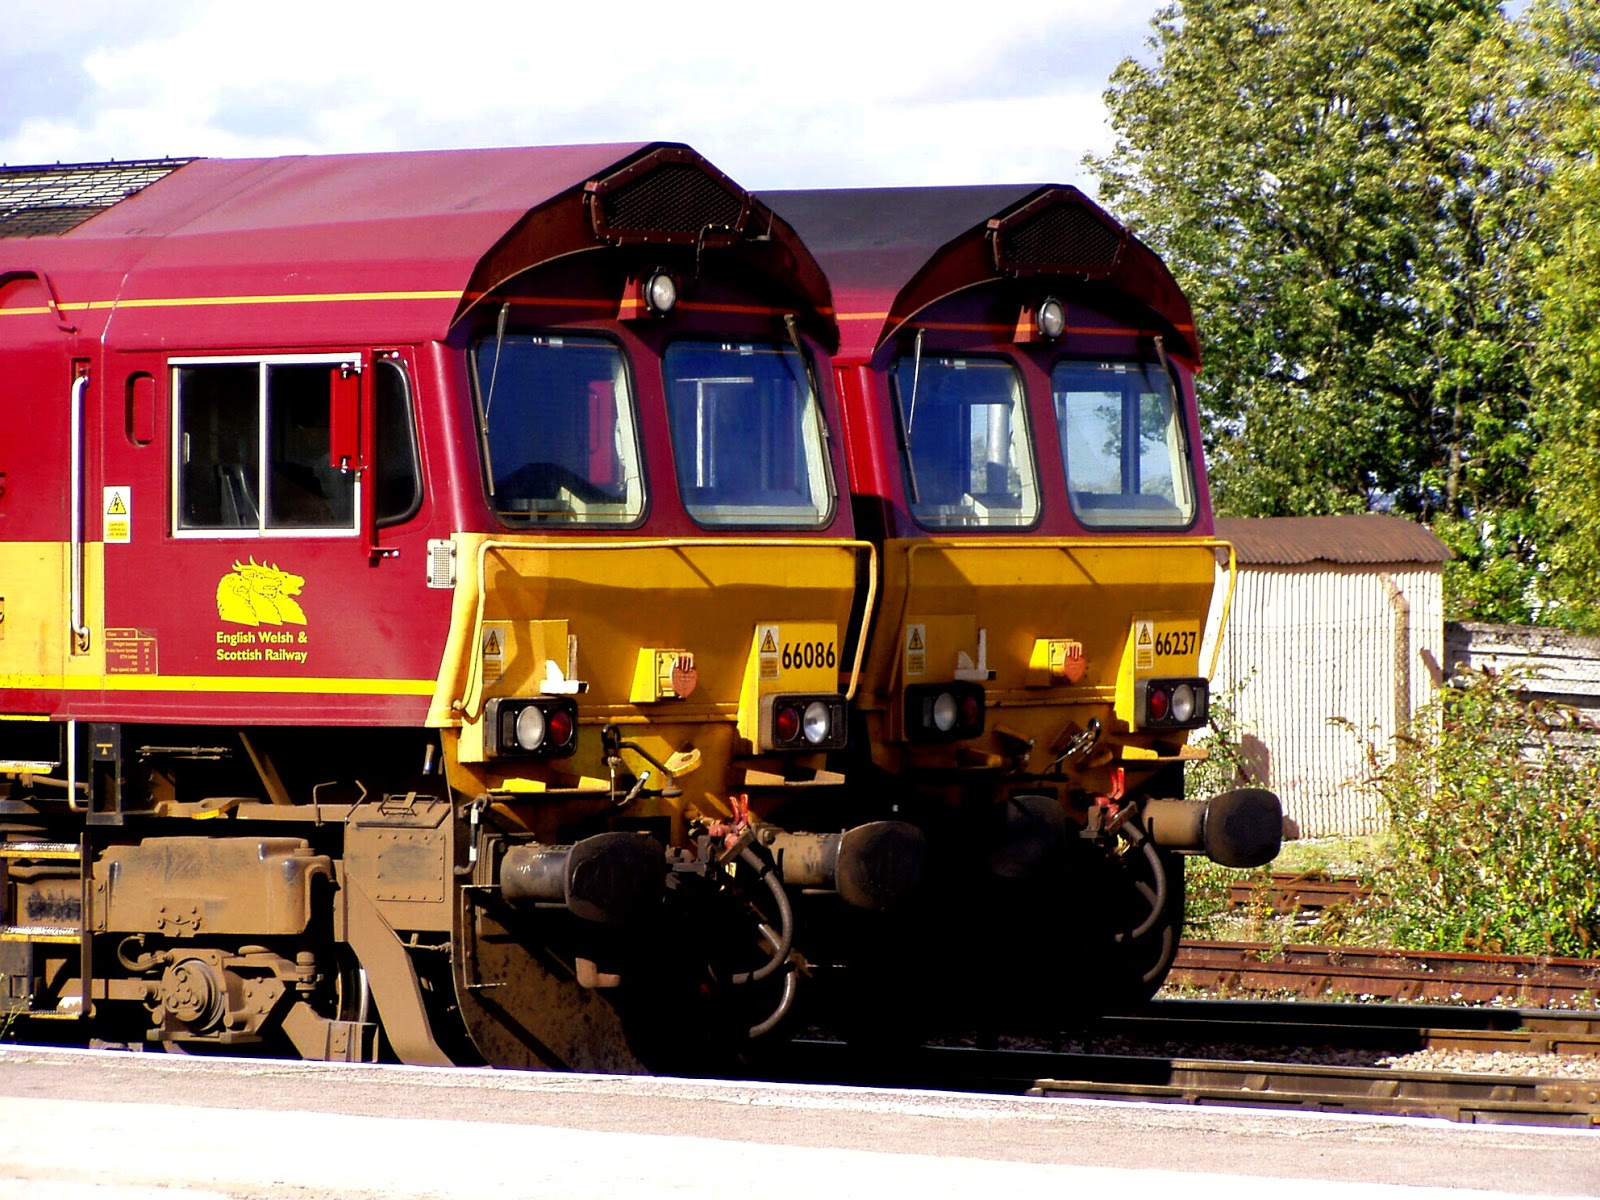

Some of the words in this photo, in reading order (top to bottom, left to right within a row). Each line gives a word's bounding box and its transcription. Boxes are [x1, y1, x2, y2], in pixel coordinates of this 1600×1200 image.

[216, 631, 256, 646] English
[257, 631, 294, 644] Welsh
[297, 631, 308, 643] &
[1155, 631, 1197, 656] 66237
[216, 648, 262, 661] Scottish
[264, 648, 308, 664] Railway
[782, 641, 836, 669] 66086
